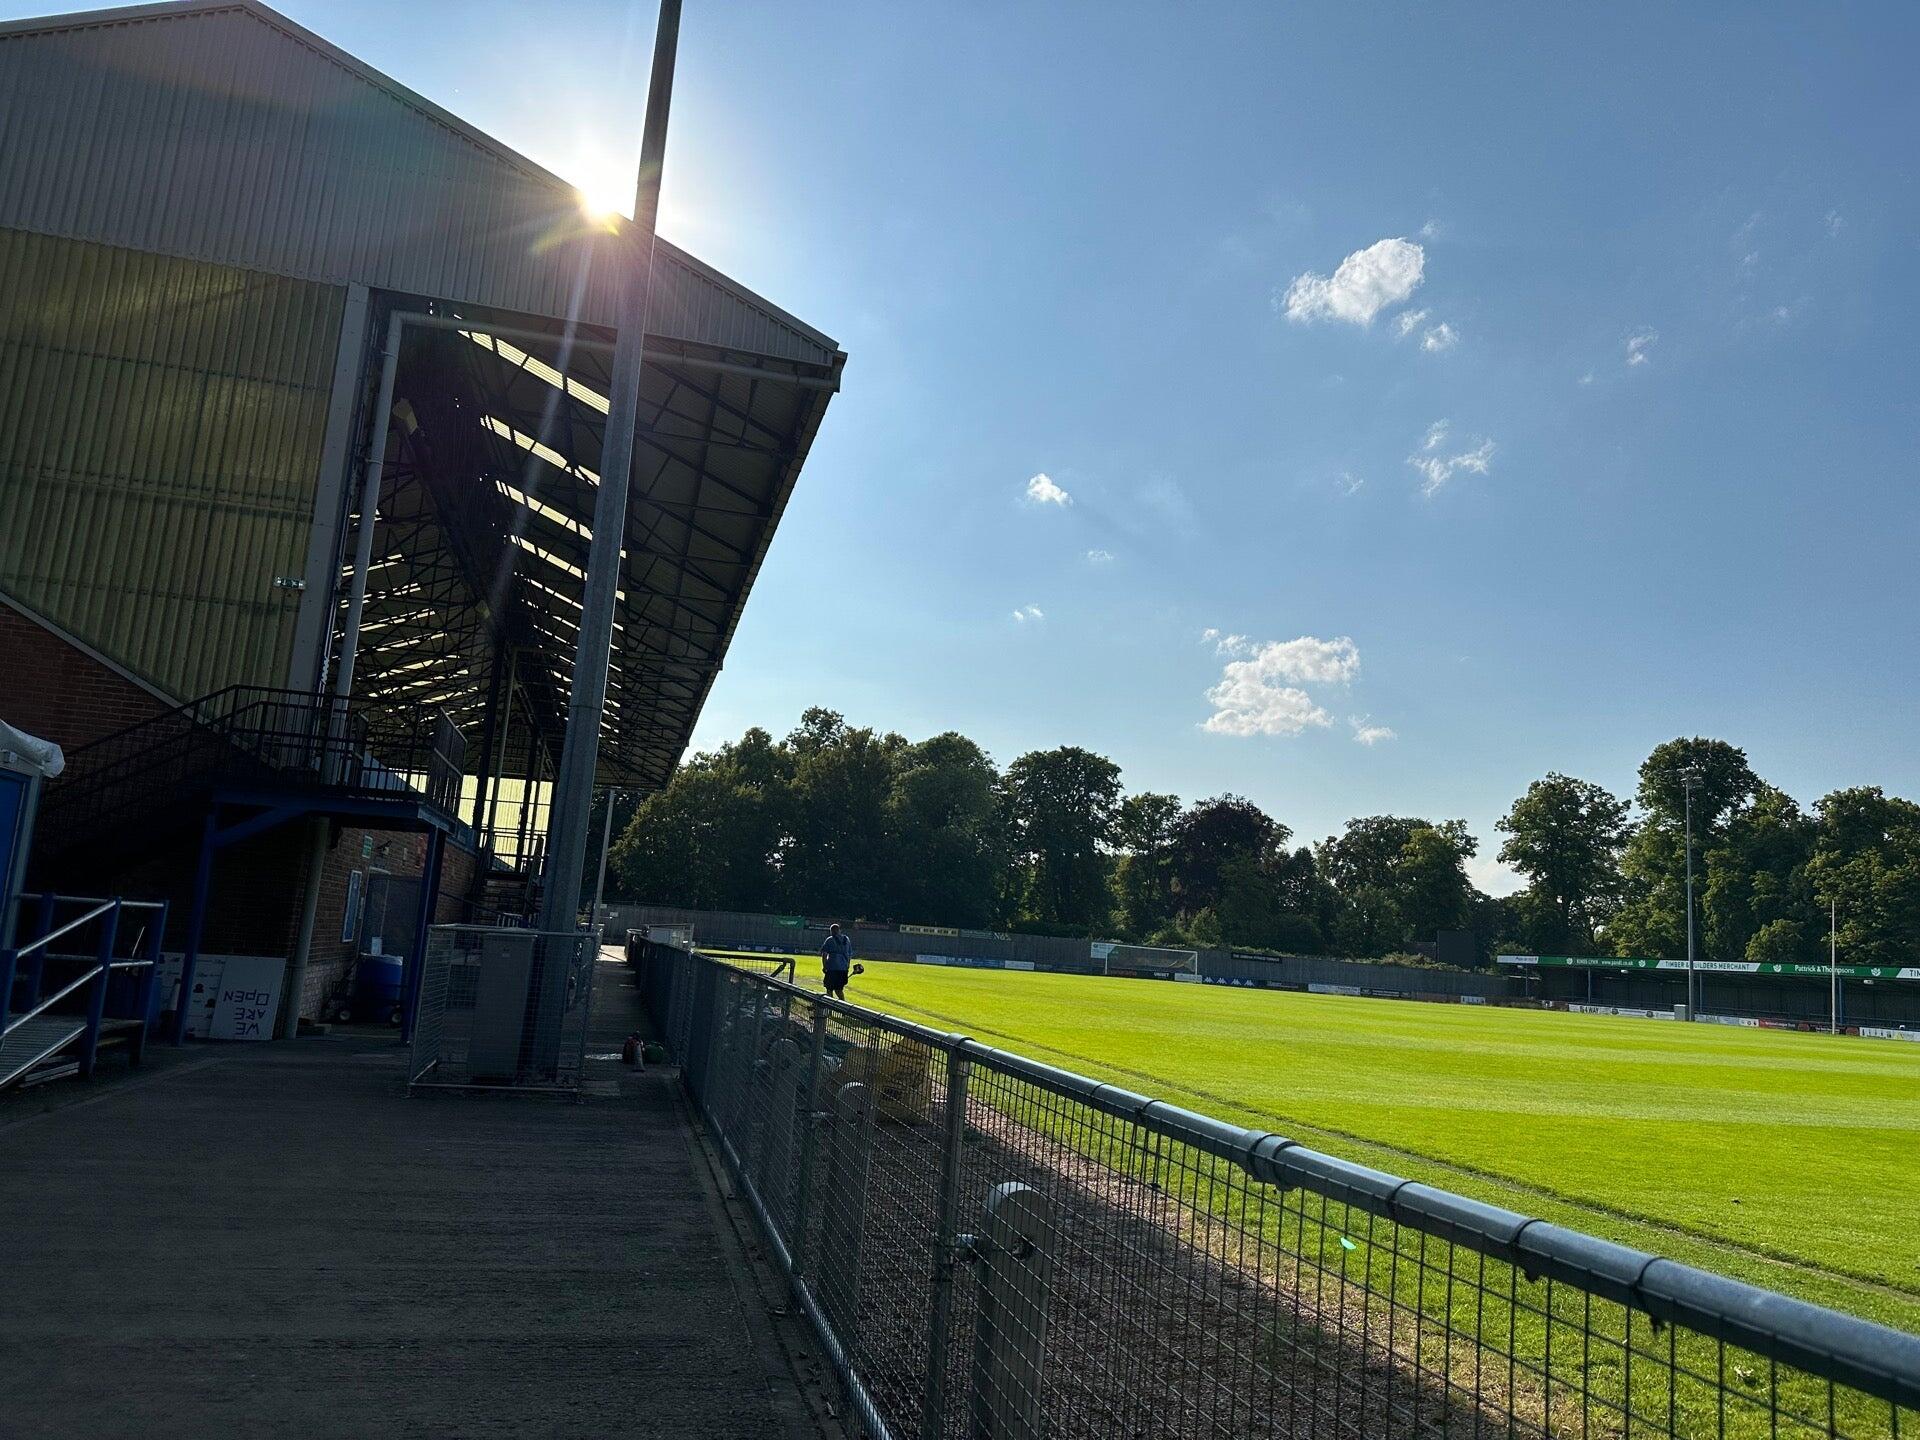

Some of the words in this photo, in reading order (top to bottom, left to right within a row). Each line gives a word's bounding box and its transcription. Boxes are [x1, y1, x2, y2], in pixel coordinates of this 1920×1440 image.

[1693, 961, 1718, 969] UILDERS
[1718, 962, 1750, 970] MERCHANT
[1794, 964, 1816, 972] Pattrick
[233, 1007, 266, 1020] ARE
[235, 1022, 260, 1035] WE
